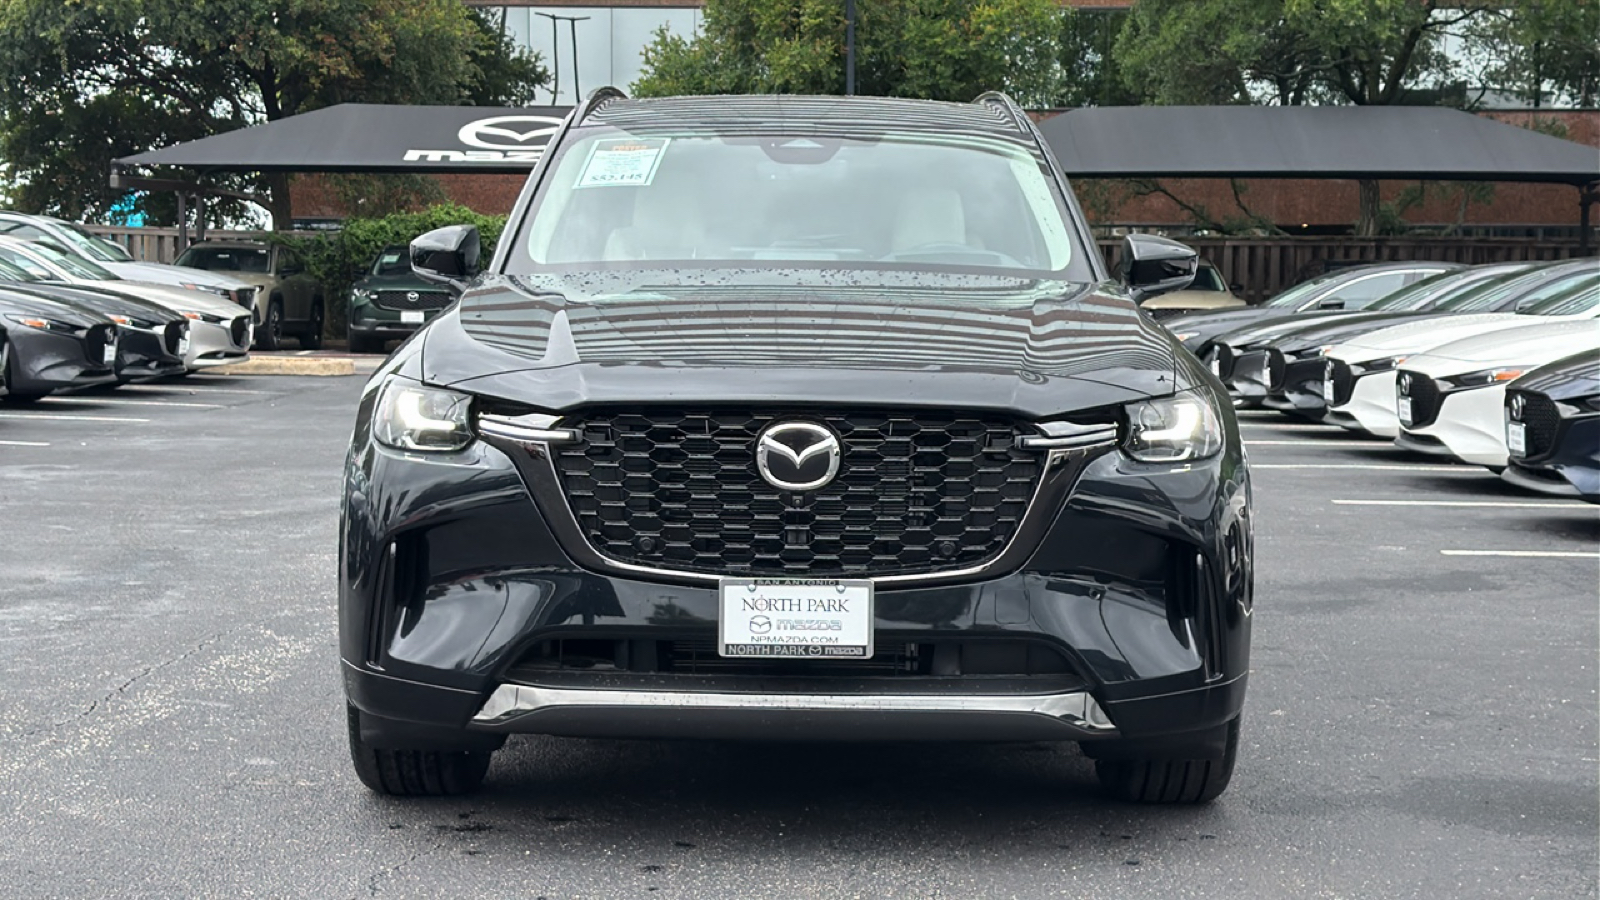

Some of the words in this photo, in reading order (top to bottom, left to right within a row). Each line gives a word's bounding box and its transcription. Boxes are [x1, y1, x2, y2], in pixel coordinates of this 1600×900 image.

[403, 149, 545, 161] maz
[741, 597, 802, 612] NORTH
[807, 598, 850, 612] PARK
[776, 619, 842, 631] mazda
[728, 644, 770, 655] NORTH
[773, 645, 806, 656] PARK
[824, 646, 863, 656] mazda
